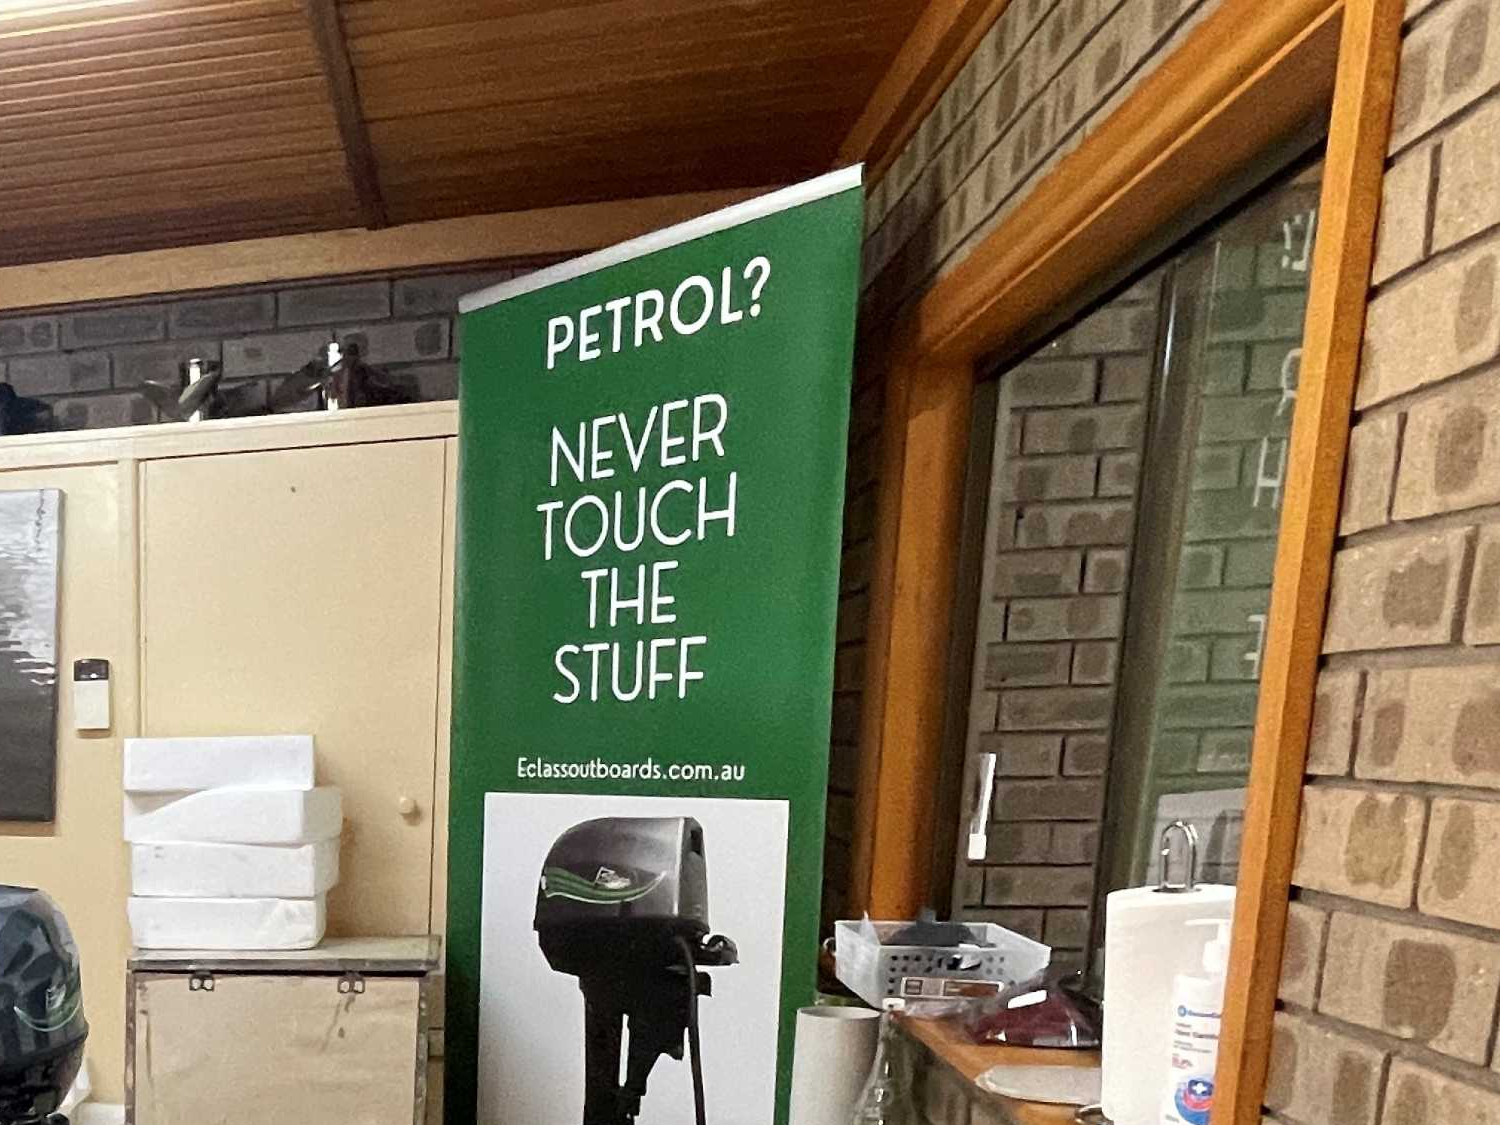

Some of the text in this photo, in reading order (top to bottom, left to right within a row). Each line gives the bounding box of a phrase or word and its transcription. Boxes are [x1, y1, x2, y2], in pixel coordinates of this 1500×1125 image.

[547, 256, 771, 370] PETROL?
[550, 394, 728, 486] NEVER
[536, 471, 737, 560] TOUCH
[581, 560, 678, 628] THE
[553, 635, 707, 704] STUFF
[517, 757, 745, 781] Eclassoutboards.com.au
